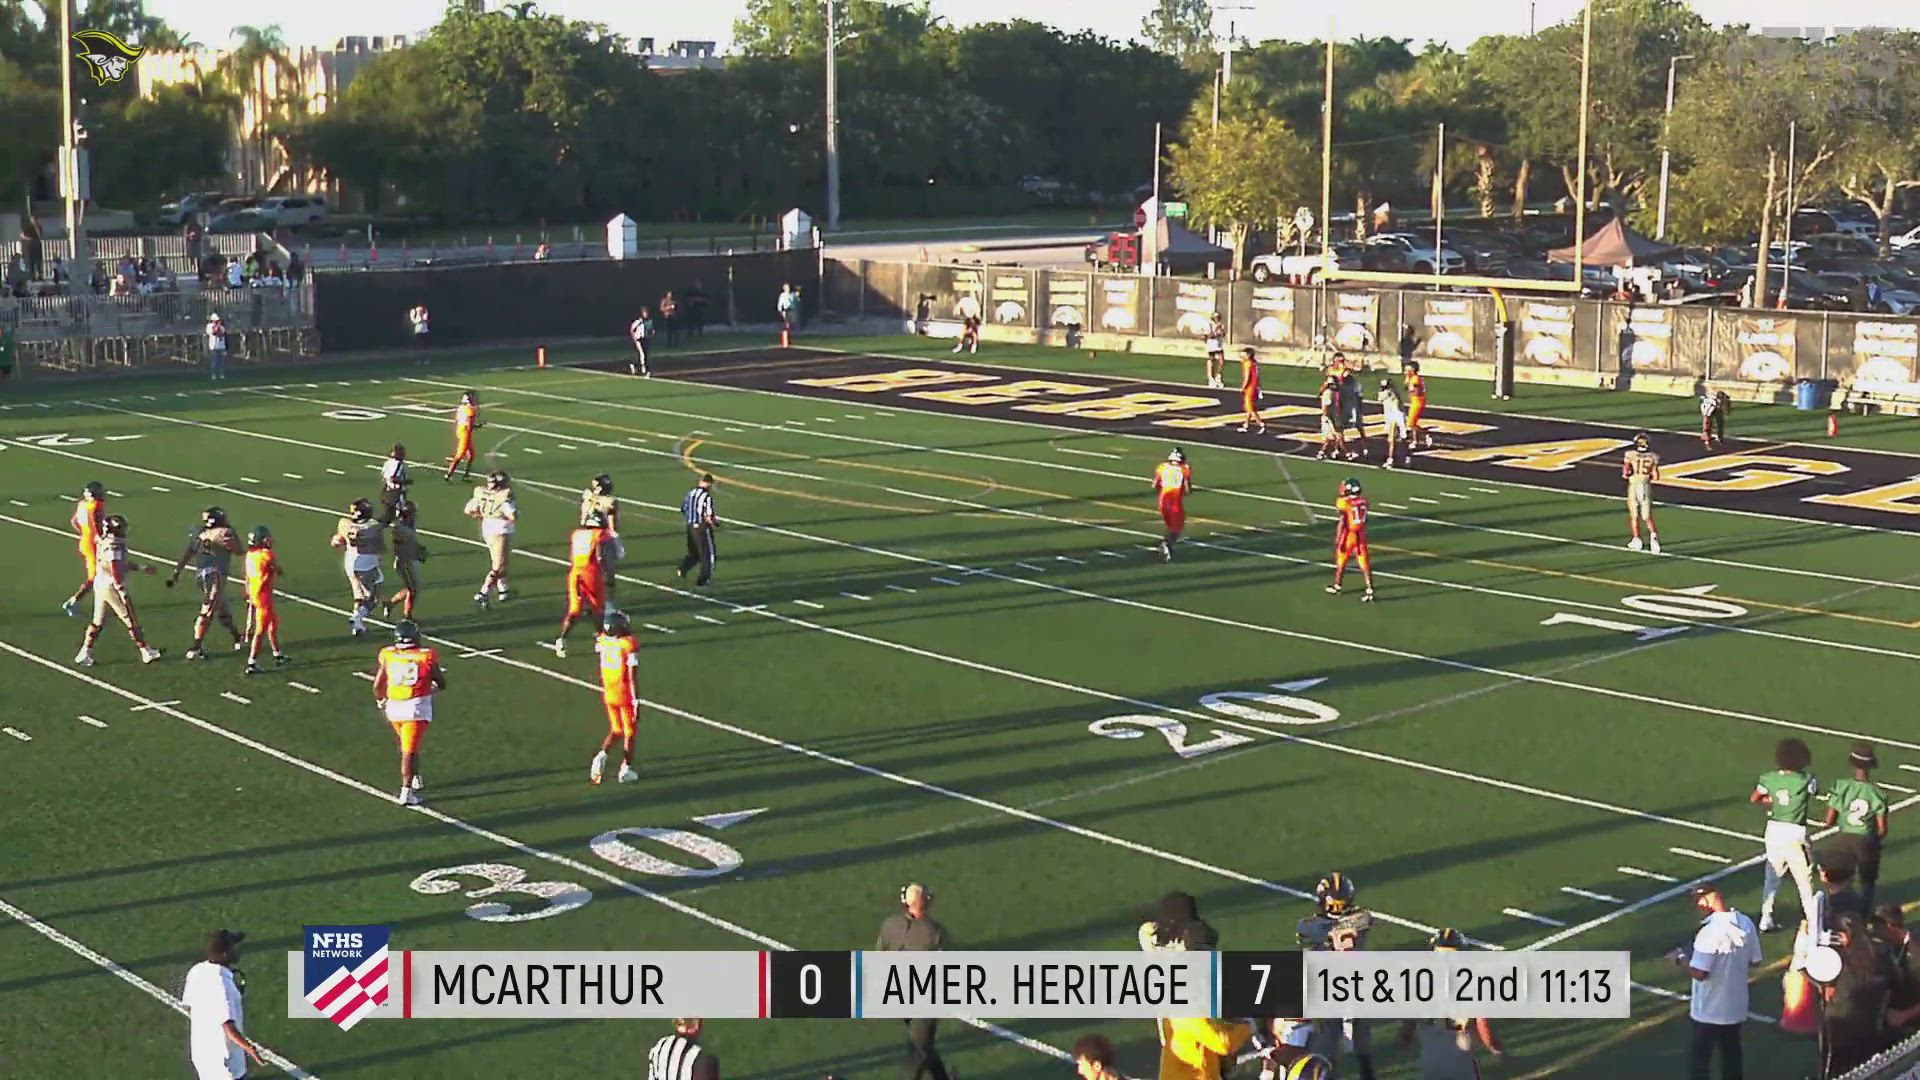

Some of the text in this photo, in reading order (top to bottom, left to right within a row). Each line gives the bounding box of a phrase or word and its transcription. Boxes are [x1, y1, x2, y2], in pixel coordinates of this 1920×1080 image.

[1108, 232, 1137, 266] 25
[1088, 690, 1342, 760] 20
[1846, 798, 1869, 826] 2
[409, 827, 744, 922] 30
